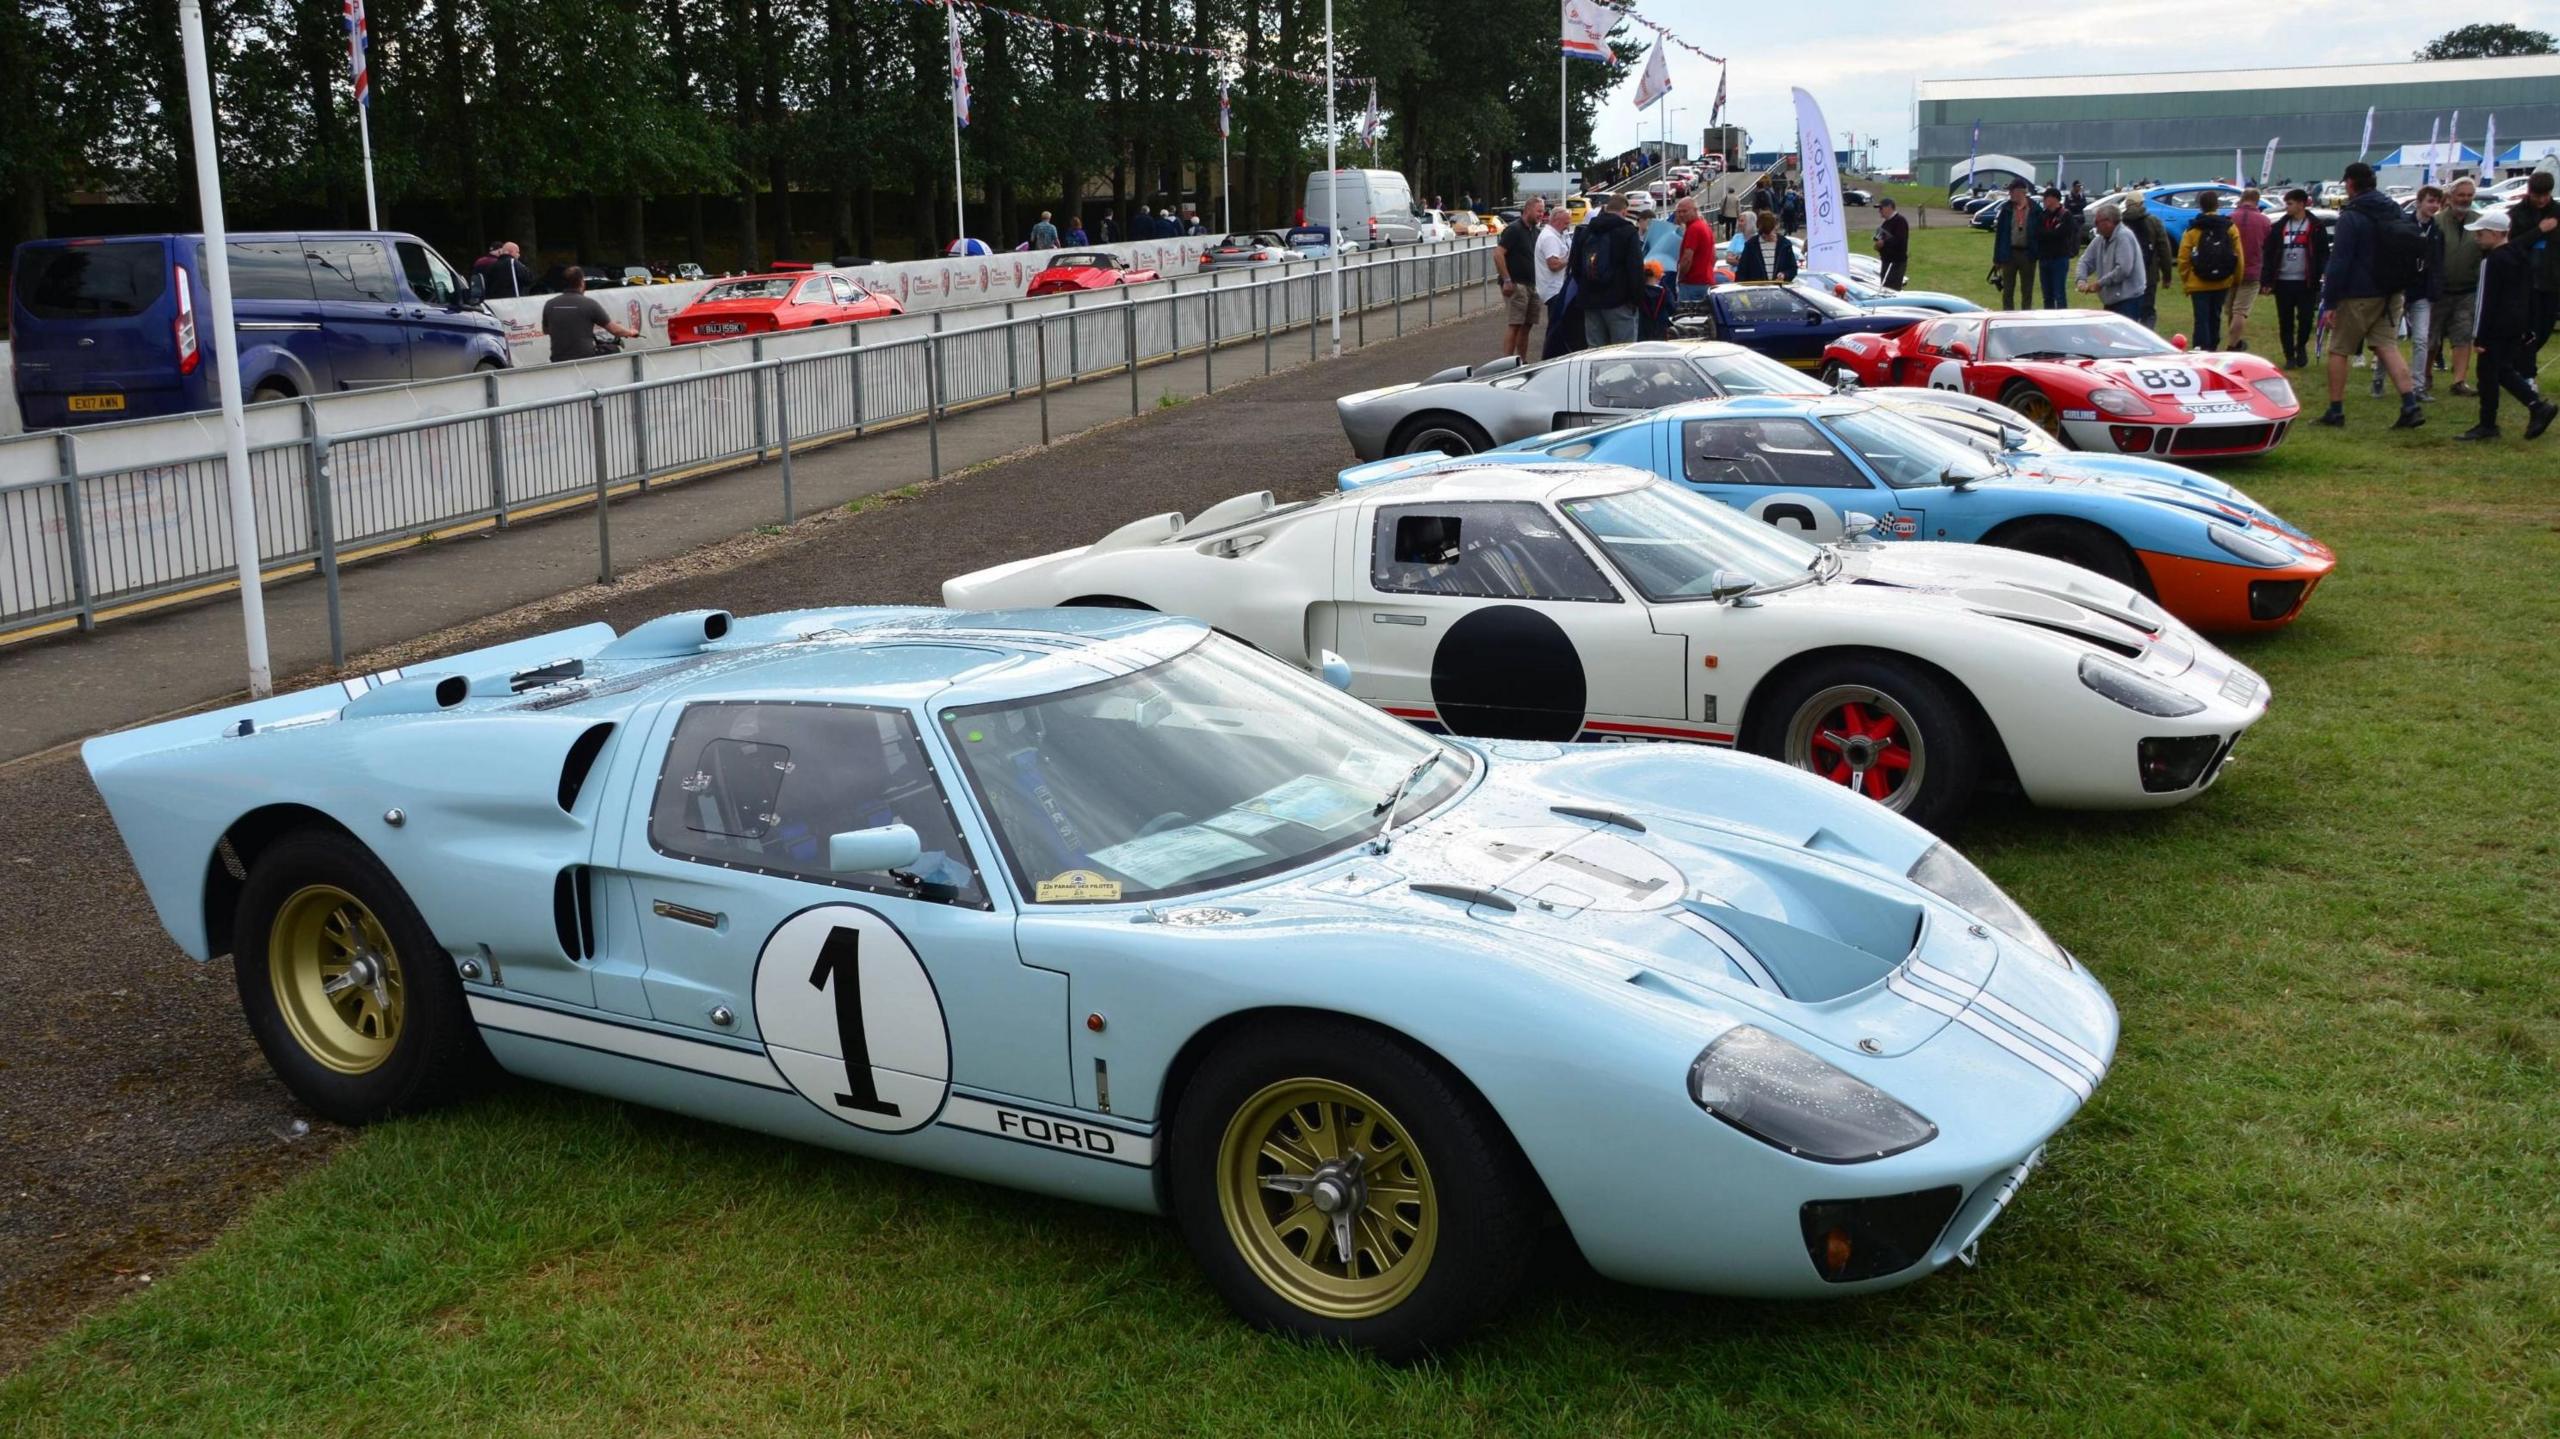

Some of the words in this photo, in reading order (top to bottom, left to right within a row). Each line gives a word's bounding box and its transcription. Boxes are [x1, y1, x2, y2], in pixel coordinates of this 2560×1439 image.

[2136, 368, 2191, 389] 83
[2062, 410, 2097, 420] GIRLING
[1893, 524, 1916, 533] Gulf
[808, 925, 902, 1117] 1
[996, 1109, 1116, 1155] FORD
